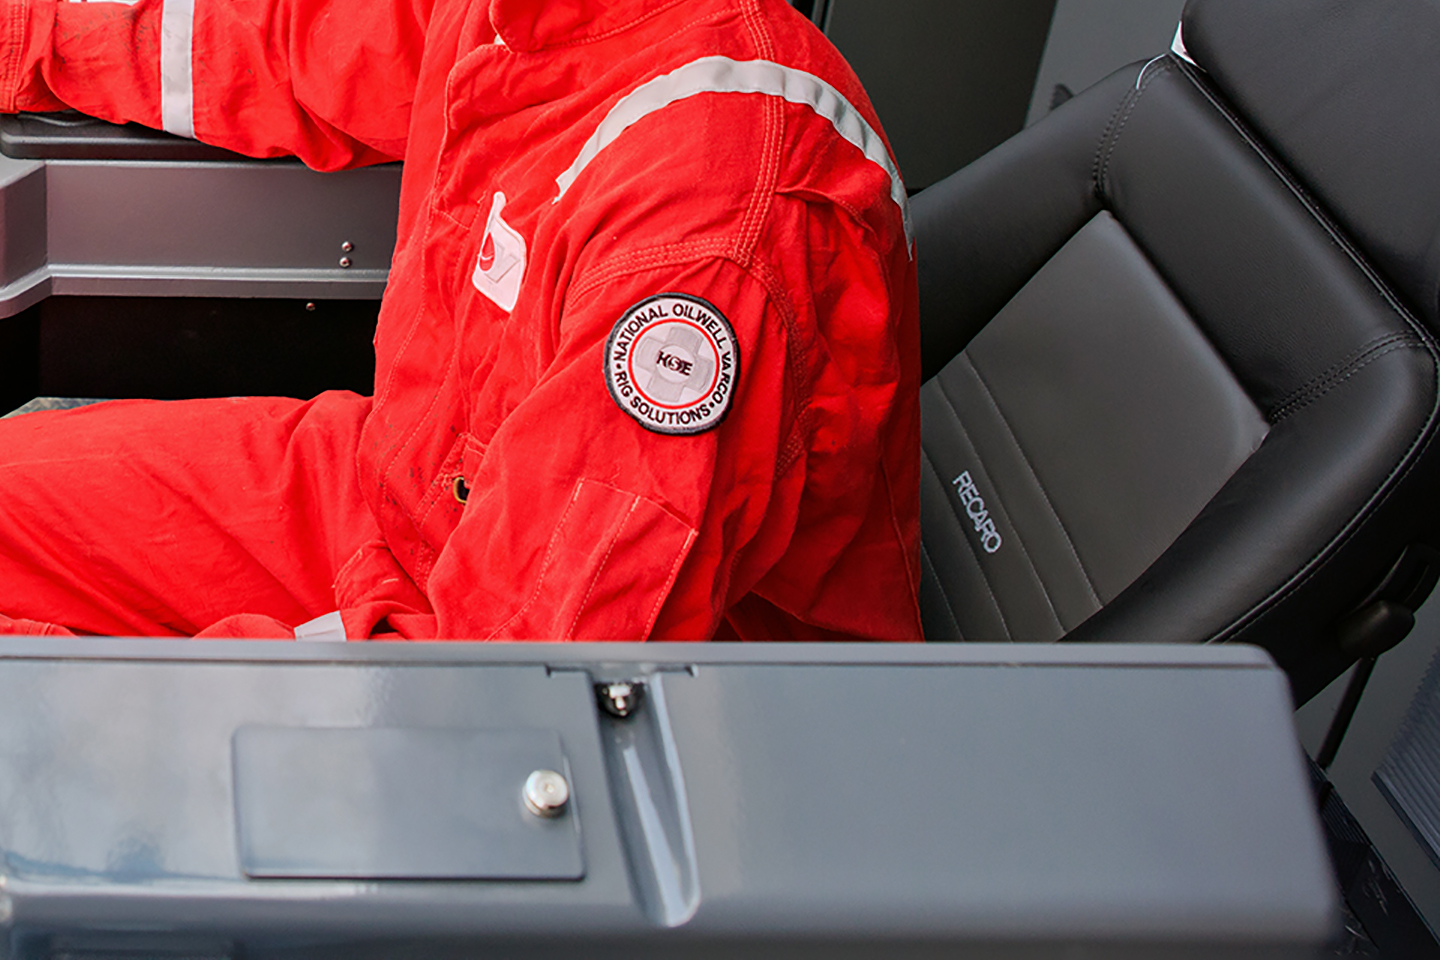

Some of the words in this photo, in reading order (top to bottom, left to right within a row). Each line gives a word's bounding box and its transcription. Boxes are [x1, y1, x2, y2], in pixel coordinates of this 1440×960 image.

[613, 305, 669, 362] NATIONAL
[672, 303, 727, 350] OILWELL
[711, 351, 732, 405] VARCO
[614, 371, 633, 398] RIG
[630, 396, 711, 425] SOLUTIONS
[952, 470, 1002, 554] RECARO
